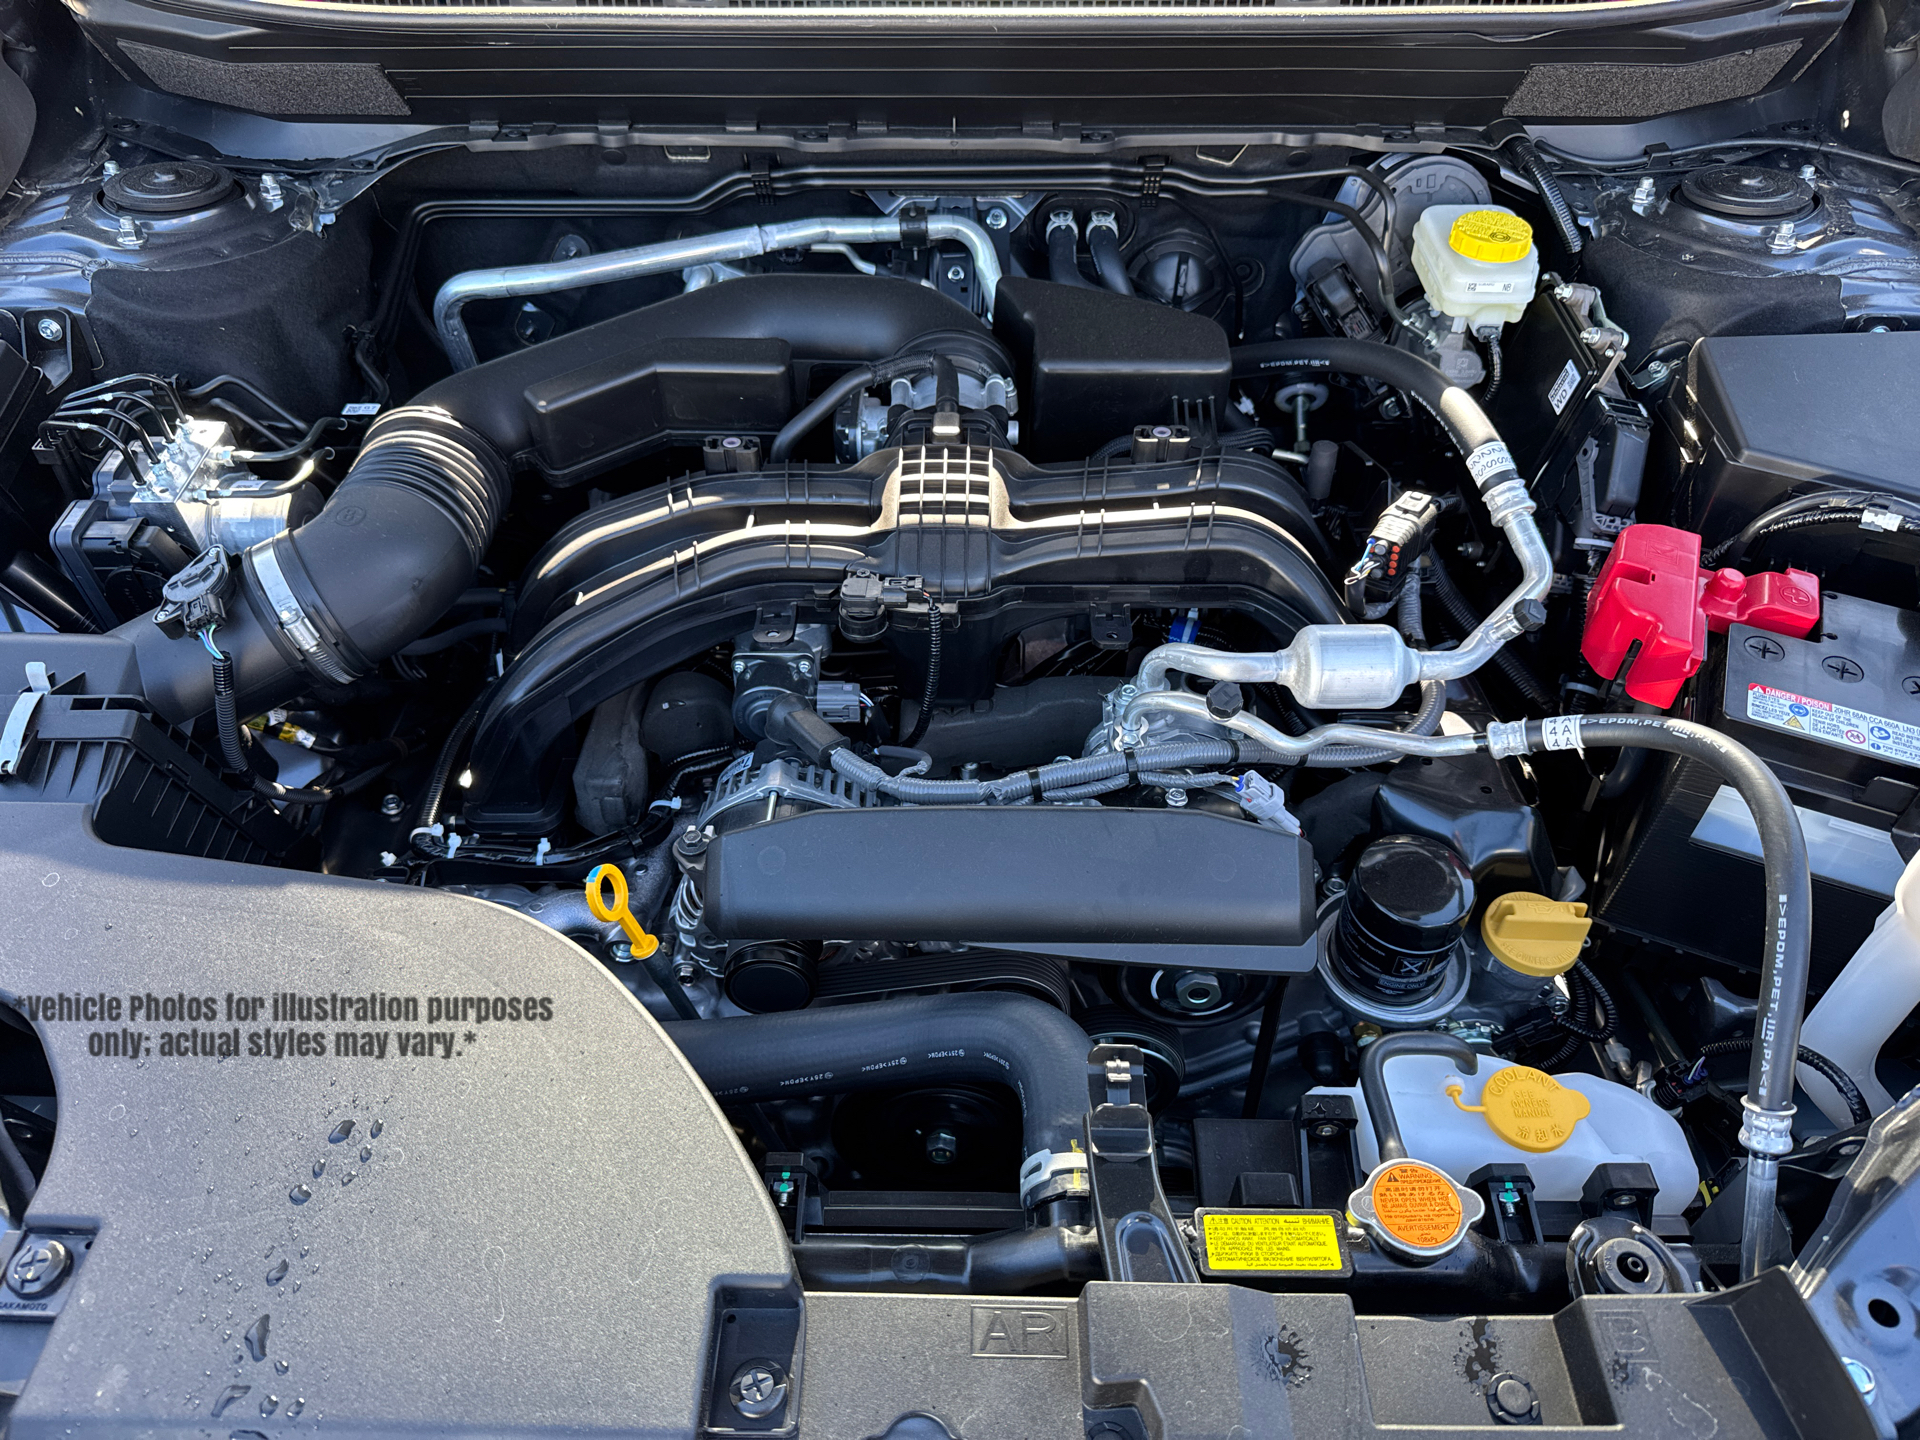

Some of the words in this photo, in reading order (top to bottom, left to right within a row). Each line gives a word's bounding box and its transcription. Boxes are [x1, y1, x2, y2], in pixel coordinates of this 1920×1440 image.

[1502, 283, 1512, 292] NB
[1766, 688, 1796, 702] DANGER
[1802, 698, 1830, 710] POISON
[1869, 716, 1883, 726] CCA
[1550, 726, 1558, 736] 4
[1562, 724, 1572, 736] A
[1489, 1068, 1560, 1096] COOLANT
[1514, 1090, 1534, 1099] SEE
[1514, 1108, 1554, 1118] MANUAL
[1398, 1224, 1450, 1232] AVERTISSEMENT
[980, 1310, 1060, 1352] AR
